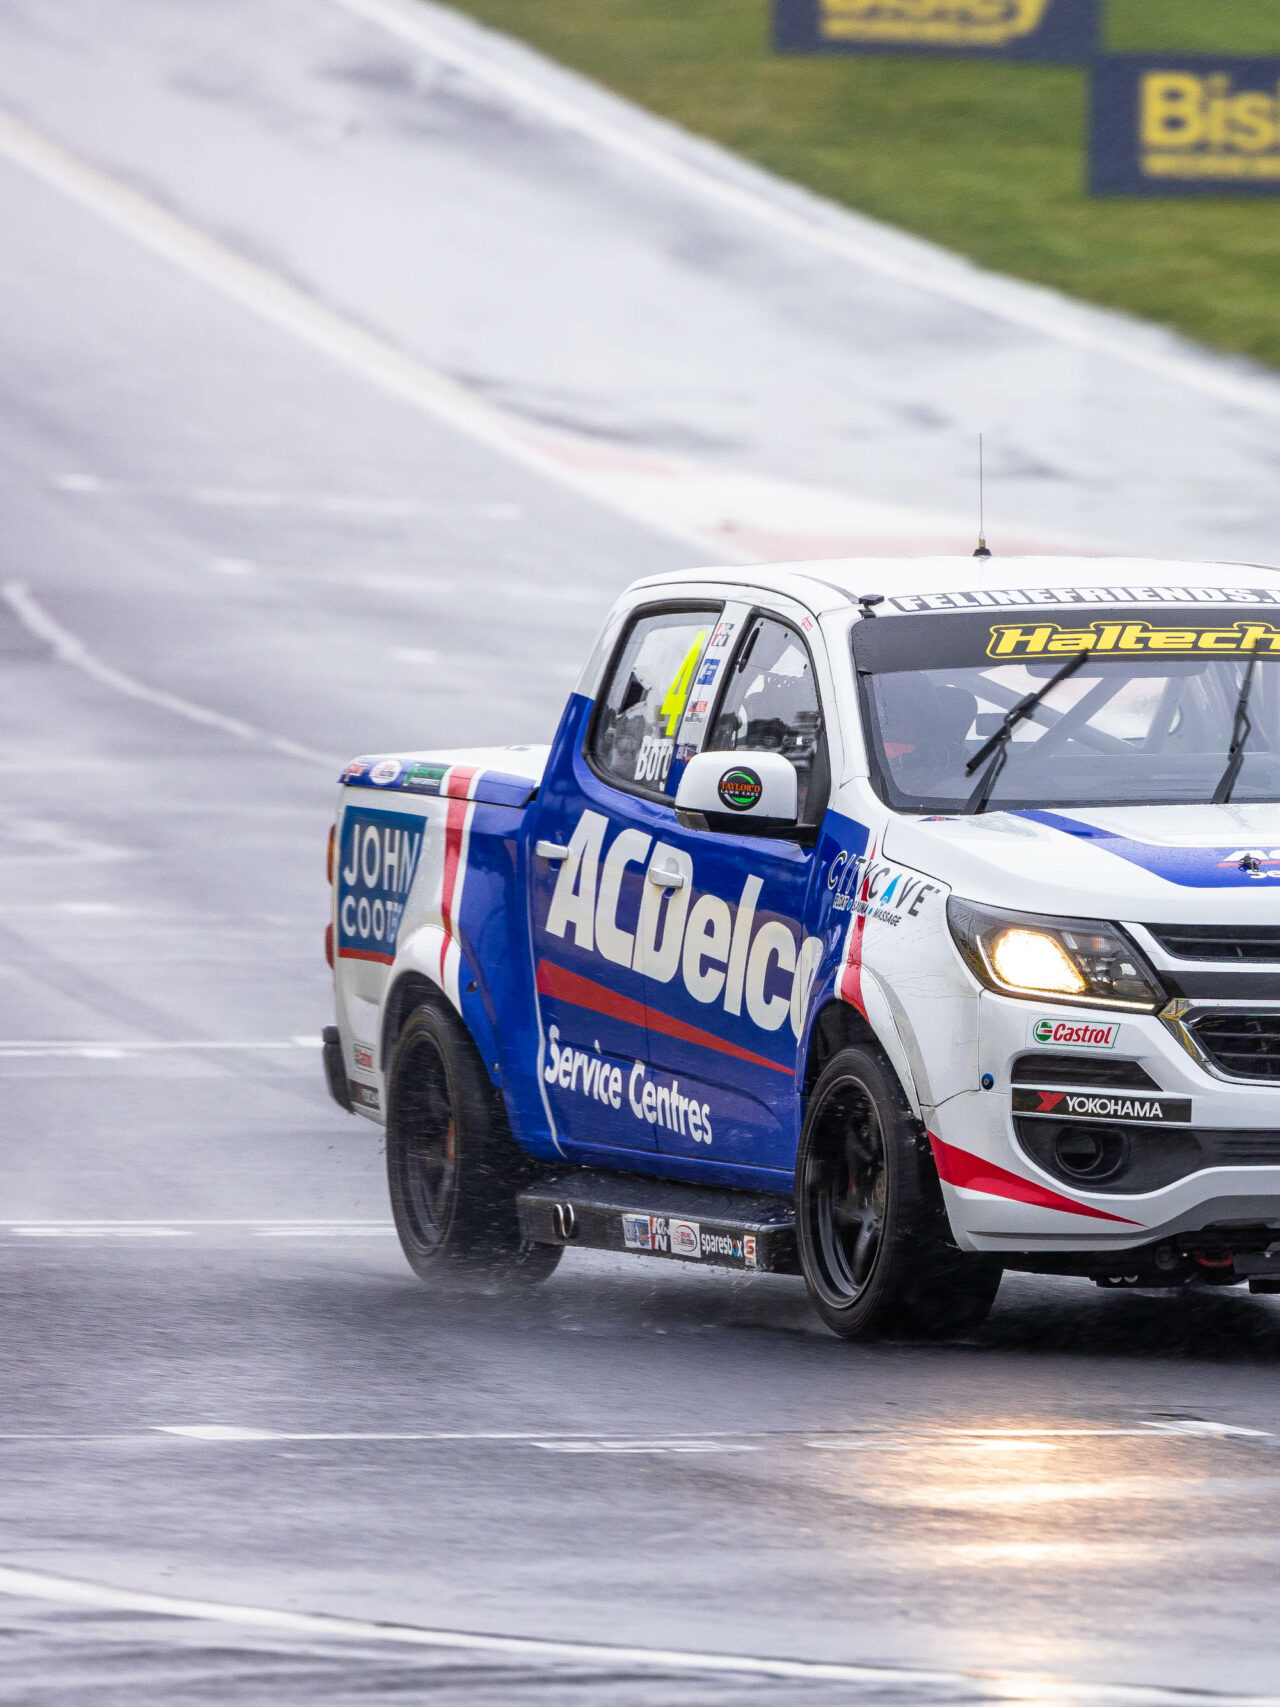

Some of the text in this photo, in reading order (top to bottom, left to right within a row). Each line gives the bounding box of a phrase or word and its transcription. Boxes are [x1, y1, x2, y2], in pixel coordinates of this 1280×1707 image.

[660, 631, 708, 736] 4
[721, 781, 760, 793] TAYLOR'D
[343, 824, 421, 894] JOHN
[545, 808, 824, 1047] ACDelco
[872, 908, 902, 927] MASSAGE
[1053, 1023, 1112, 1044] Castrol
[545, 1024, 713, 1145] Service Centres
[1066, 1095, 1163, 1118] YOKOHAMA
[701, 1233, 743, 1258] sparesbox
